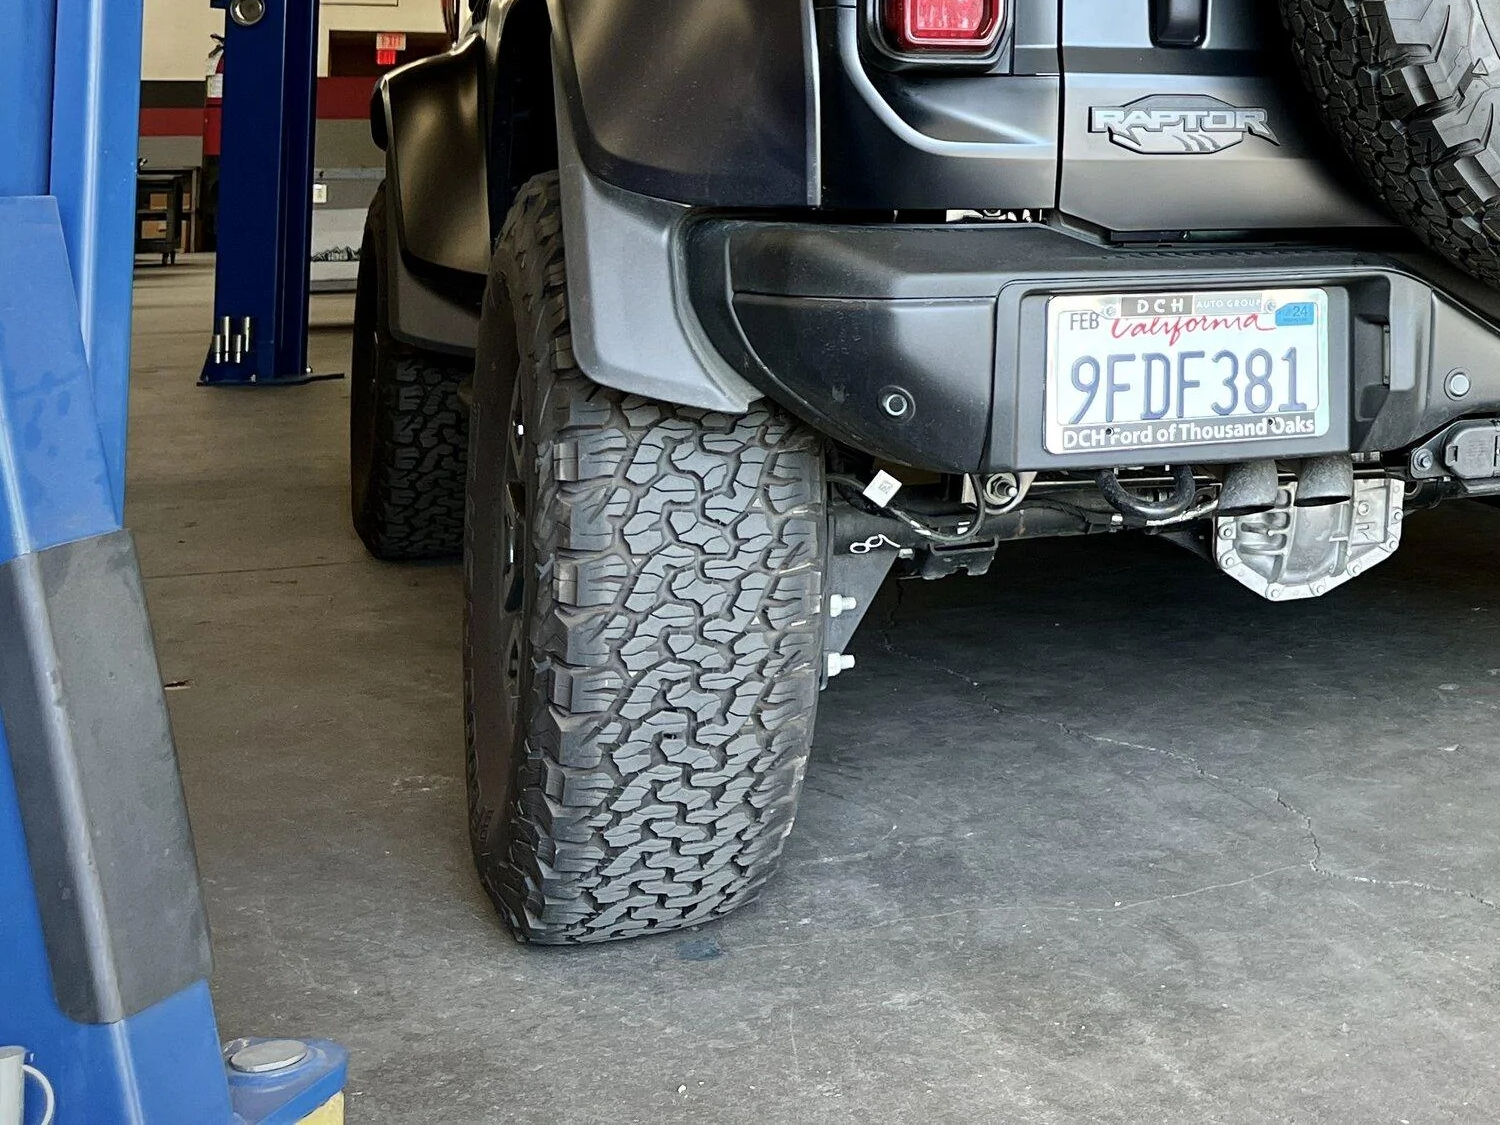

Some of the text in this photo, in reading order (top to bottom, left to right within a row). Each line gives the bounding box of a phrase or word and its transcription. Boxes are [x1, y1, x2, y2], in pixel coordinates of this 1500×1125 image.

[1092, 107, 1280, 146] RAPTOR
[1069, 312, 1099, 331] FEB
[1136, 297, 1185, 314] DCH
[1196, 299, 1224, 310] AUTO
[1110, 312, 1276, 347] California
[1068, 346, 1307, 424] 9FDF381
[1064, 428, 1106, 448] DCH
[1156, 423, 1176, 441] of
[1178, 419, 1268, 440] Thousand
[1271, 417, 1315, 435] Oaks
